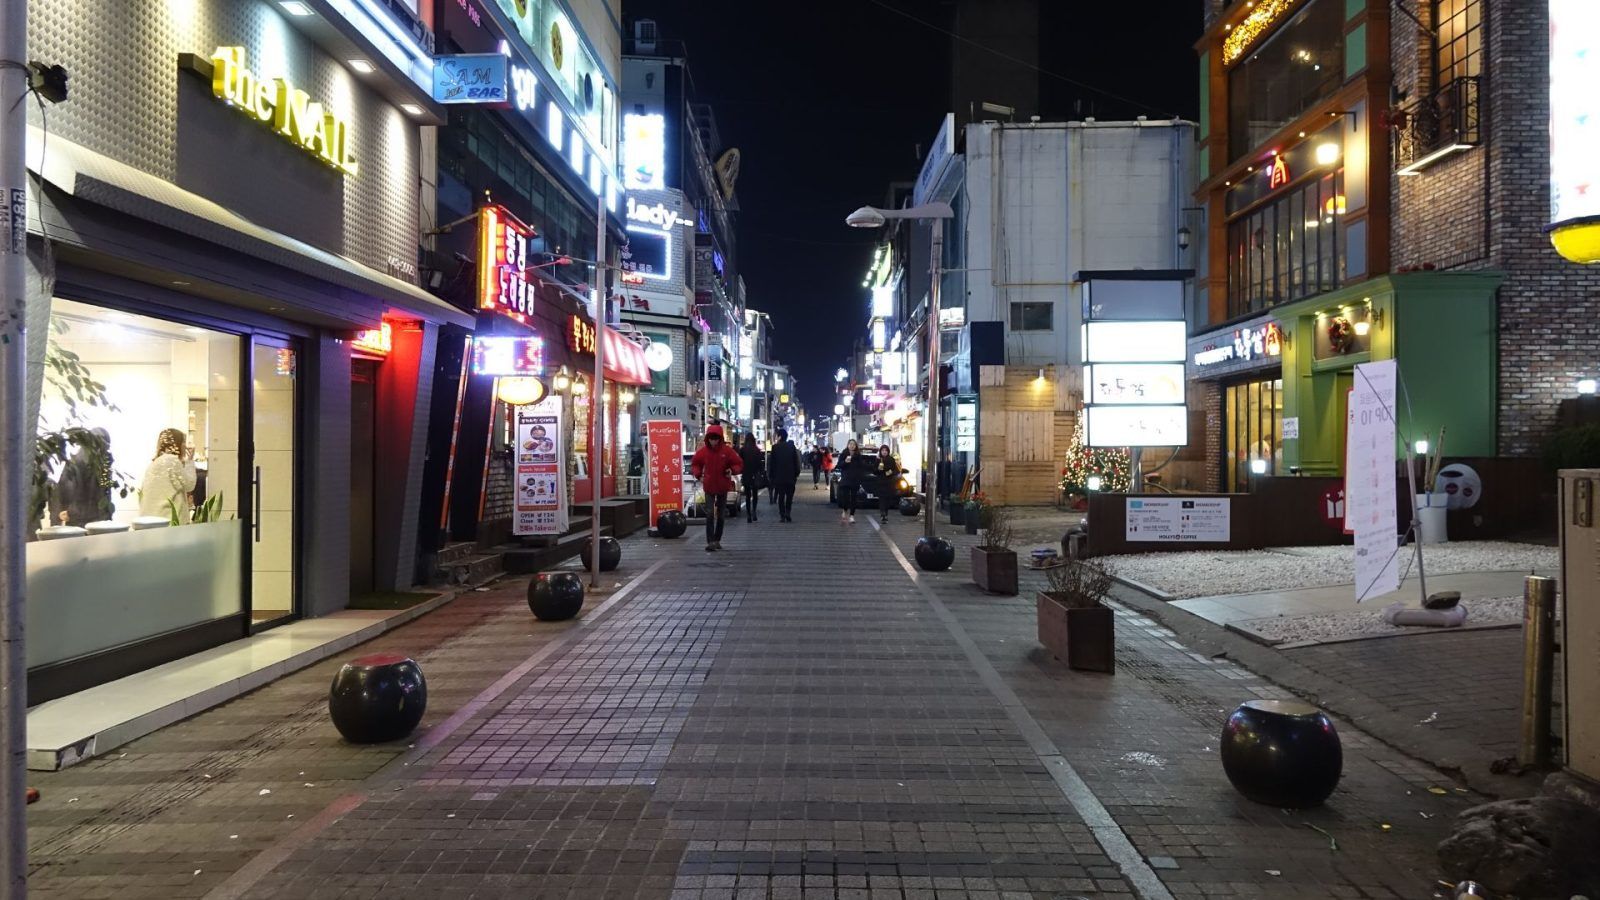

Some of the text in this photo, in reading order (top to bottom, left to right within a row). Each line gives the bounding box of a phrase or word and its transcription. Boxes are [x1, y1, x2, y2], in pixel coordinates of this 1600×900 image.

[440, 60, 492, 86] SAM
[467, 87, 501, 98] BAR
[211, 46, 359, 177] the NAIL
[648, 406, 678, 416] VIKI
